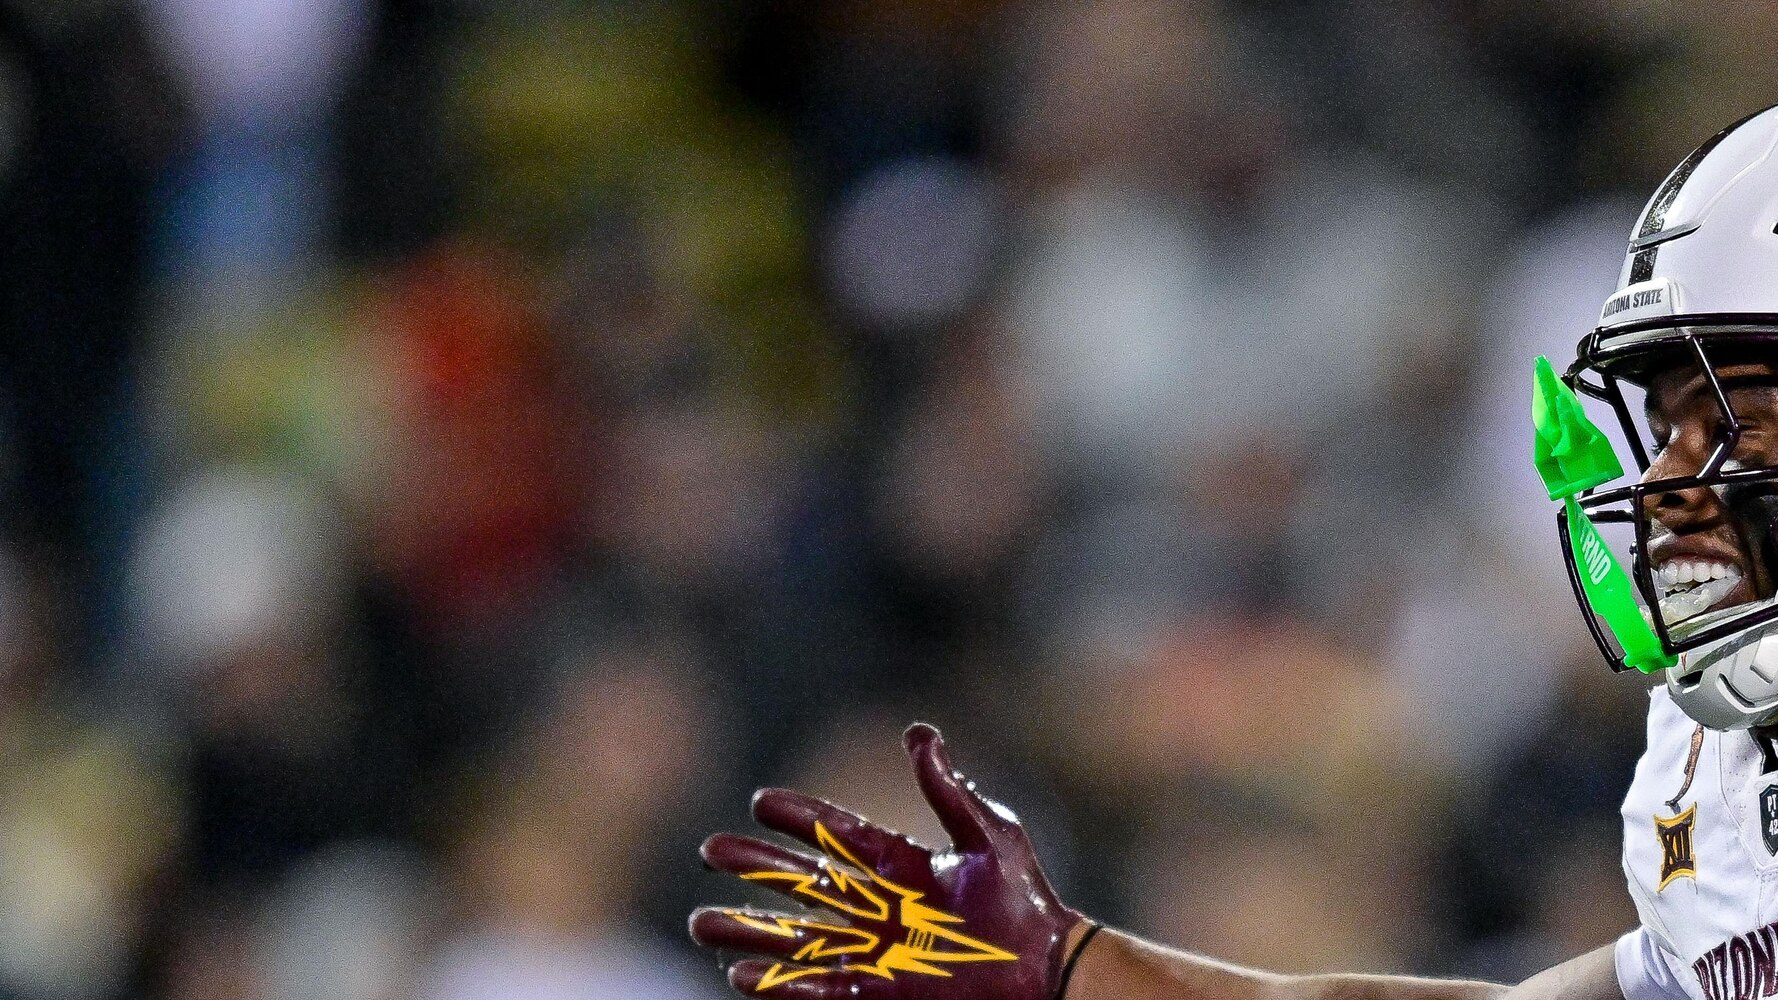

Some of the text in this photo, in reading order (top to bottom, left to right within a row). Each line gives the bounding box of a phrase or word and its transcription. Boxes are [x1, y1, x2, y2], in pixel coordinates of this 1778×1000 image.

[1632, 288, 1664, 308] STATE
[1767, 794, 1777, 813] PT
[1768, 819, 1778, 836] 42
